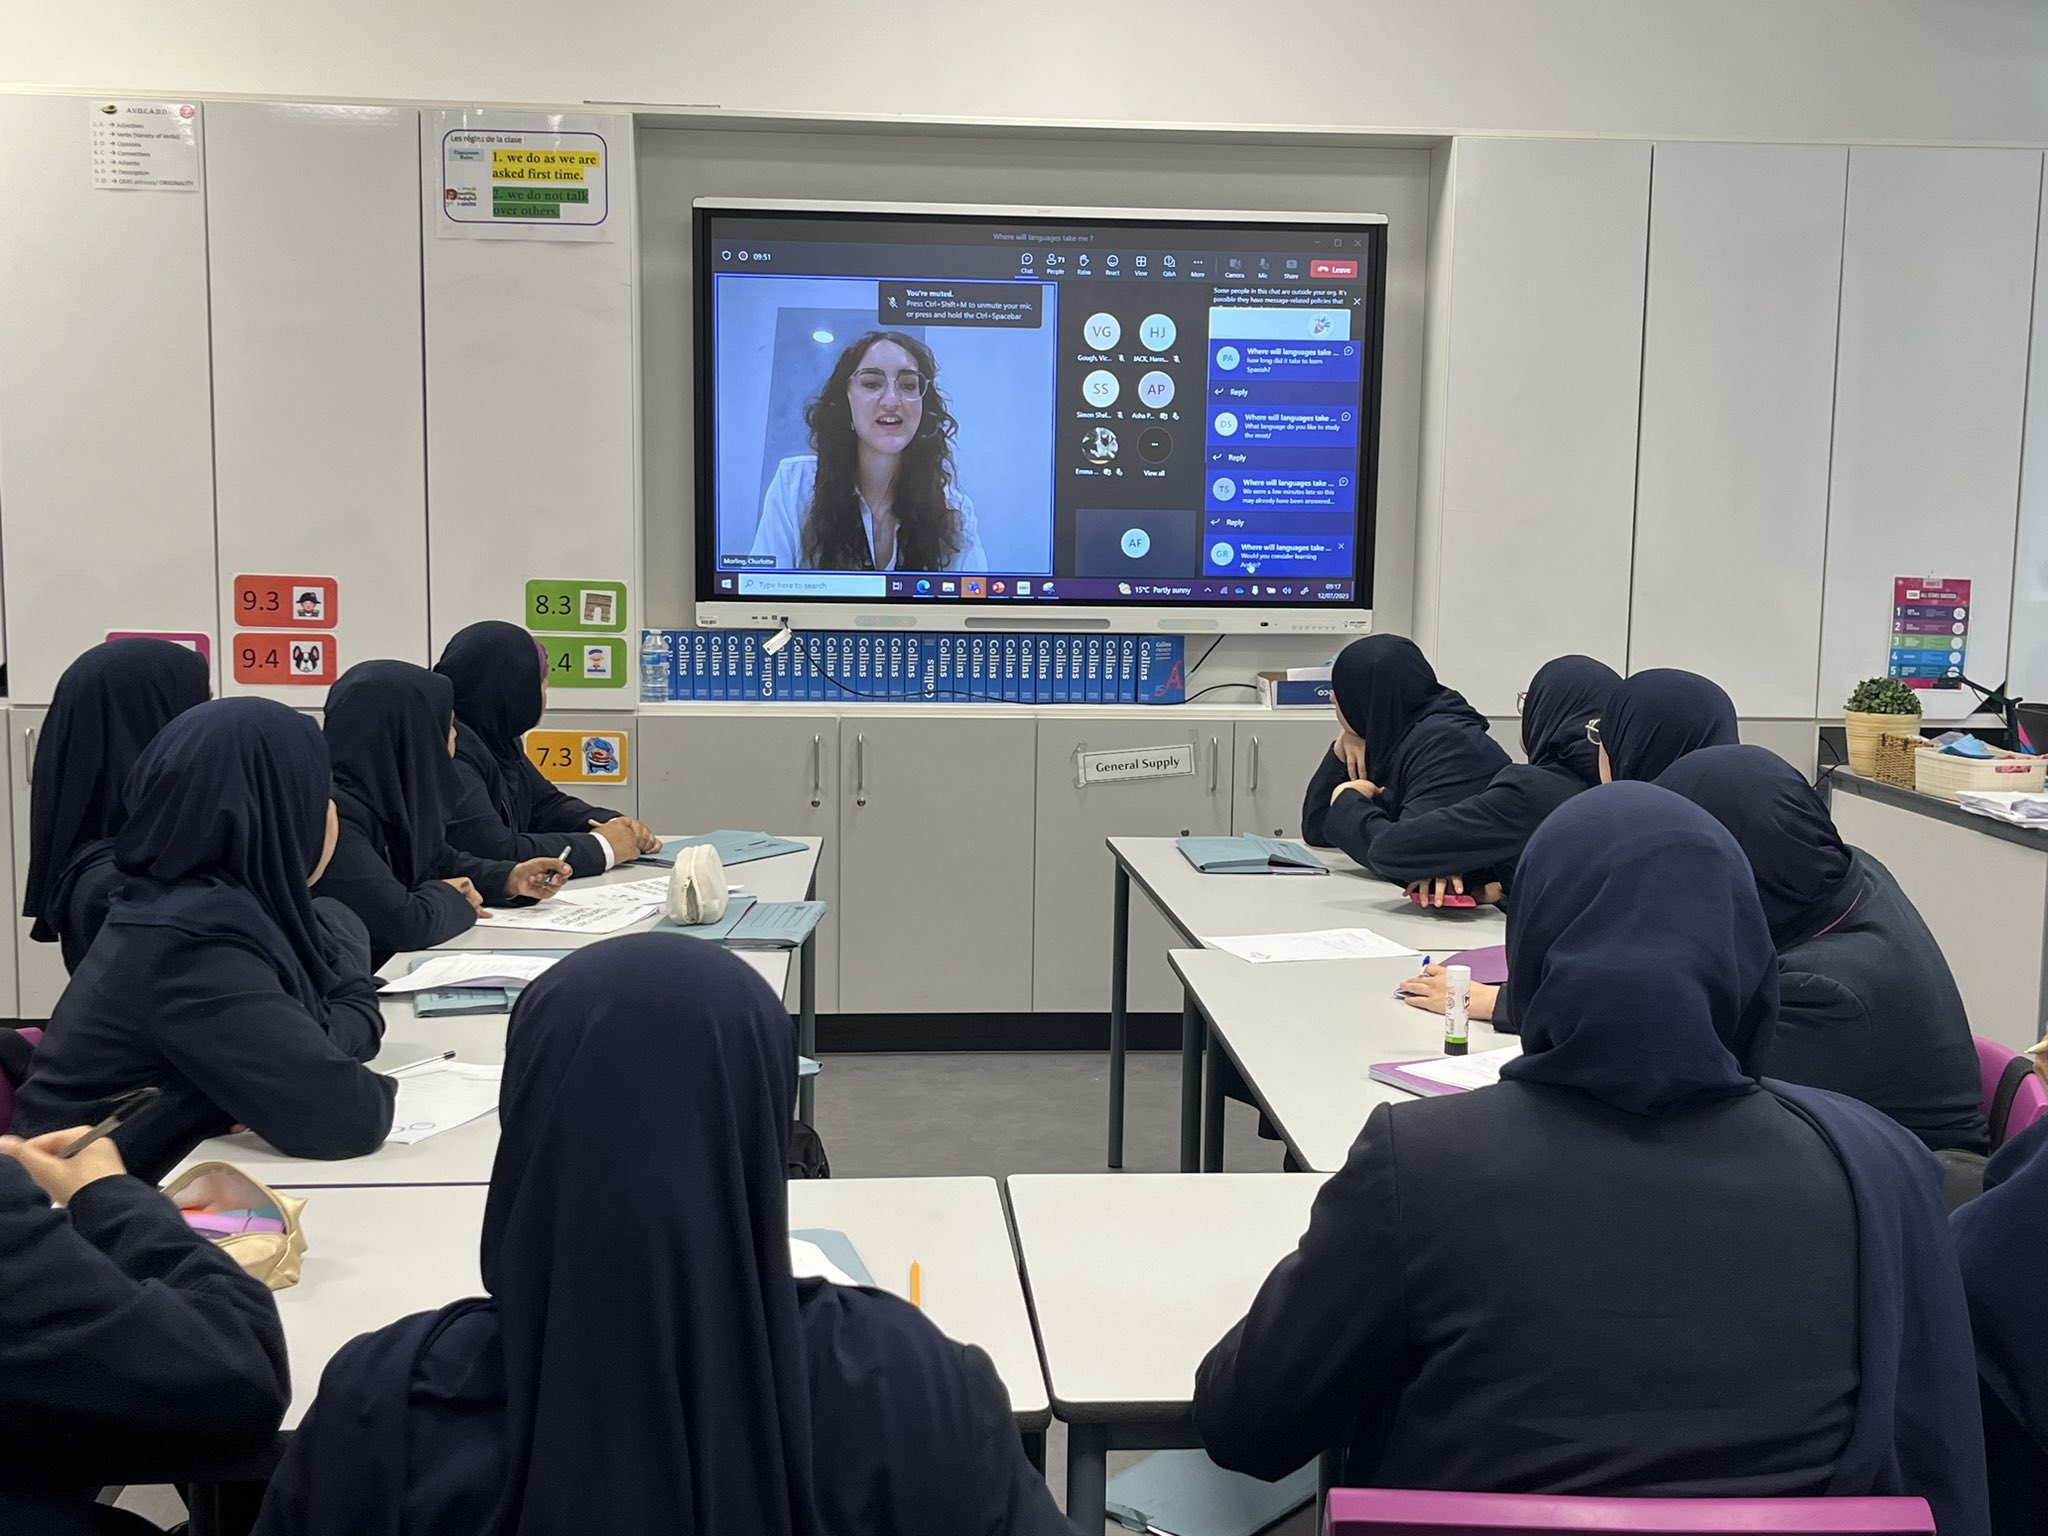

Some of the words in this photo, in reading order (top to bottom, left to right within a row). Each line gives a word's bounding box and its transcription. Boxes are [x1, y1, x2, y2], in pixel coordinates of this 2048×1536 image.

[493, 152, 502, 163] 1.
[507, 154, 523, 163] we
[526, 152, 540, 164] do
[544, 155, 556, 164] as
[560, 155, 576, 164] we
[578, 156, 596, 165] are
[492, 168, 524, 179] asked
[528, 168, 551, 180] first
[554, 170, 584, 181] time.
[493, 188, 503, 199] 2.
[507, 190, 524, 200] we
[527, 188, 541, 200] do
[545, 190, 563, 201] not
[566, 190, 588, 202] talk
[493, 206, 518, 216] over
[521, 205, 560, 217] others.
[1028, 234, 1061, 243] languages
[1062, 234, 1076, 242] take
[753, 252, 772, 260] 09:51
[1057, 256, 1065, 264] 71
[1046, 268, 1065, 276] People
[1077, 268, 1091, 276] Raise
[1162, 270, 1176, 278] Q&A
[1284, 272, 1299, 280] Share
[1332, 266, 1352, 274] Leave
[929, 290, 954, 298] muted.
[1230, 288, 1250, 296] people
[1268, 288, 1280, 296] chat
[1292, 288, 1312, 296] outside
[1326, 290, 1338, 298] org.
[906, 300, 924, 308] Press
[924, 300, 967, 308] Ctrl+Shift+M
[1213, 296, 1236, 304] possible
[1265, 297, 1310, 305] message-related
[964, 312, 974, 320] the
[976, 312, 1022, 322] Ctrl+Spacebar
[1092, 326, 1112, 338] VG
[1150, 327, 1166, 338] HJ
[1222, 354, 1233, 362] PA
[1270, 348, 1282, 356] will
[1283, 348, 1316, 357] languages
[1093, 383, 1108, 394] SS
[1148, 384, 1166, 395] AP
[1230, 388, 1248, 398] Reply
[1220, 420, 1232, 428] DS
[1268, 414, 1280, 422] will
[1280, 414, 1314, 422] languages
[1228, 454, 1246, 463] Reply
[1278, 480, 1312, 488] languages
[1226, 519, 1244, 528] Reply
[1128, 538, 1142, 548] AF
[1276, 544, 1310, 552] languages
[1310, 544, 1325, 552] take
[1216, 550, 1228, 558] GR
[760, 582, 776, 590] Type
[804, 582, 827, 590] search
[1134, 586, 1150, 594] 15°C
[1153, 586, 1171, 596] Partly
[1172, 587, 1191, 596] sunny
[243, 590, 280, 611] 9.3
[536, 594, 572, 615] 8.3
[1896, 607, 1900, 616] 1
[1894, 622, 1900, 631] 2
[1893, 637, 1900, 646] 3
[242, 648, 279, 668] 9.4
[678, 636, 690, 676] Collins
[696, 636, 706, 676] Collins
[712, 636, 722, 676] Collins
[728, 636, 739, 676] Collins
[744, 636, 756, 676] Collins
[778, 644, 788, 676] ollins
[794, 637, 804, 676] Collins
[810, 638, 821, 678] Collins
[826, 638, 837, 678] Collins
[843, 638, 854, 678] Collins
[859, 638, 870, 678] Collins
[875, 638, 886, 678] Collins
[892, 638, 902, 678] Collins
[908, 638, 918, 678] Collins
[940, 638, 950, 678] Collins
[956, 638, 967, 678] Collins
[973, 639, 984, 678] Collins
[990, 640, 1000, 679] Collins
[1006, 640, 1016, 679] Collins
[1022, 640, 1032, 679] Collins
[1039, 640, 1050, 680] Collins
[1056, 640, 1066, 680] Collins
[1072, 640, 1083, 680] Collins
[1088, 640, 1100, 680] Collins
[1105, 640, 1116, 680] Collins
[1122, 640, 1133, 680] Collins
[1140, 642, 1150, 681] Collins
[1892, 652, 1898, 660] 4
[762, 656, 772, 697] Collins
[1890, 666, 1896, 675] 5
[924, 659, 934, 698] Collins
[537, 748, 572, 768] 7.3
[1096, 759, 1139, 772] General
[1142, 756, 1180, 770] Supply
